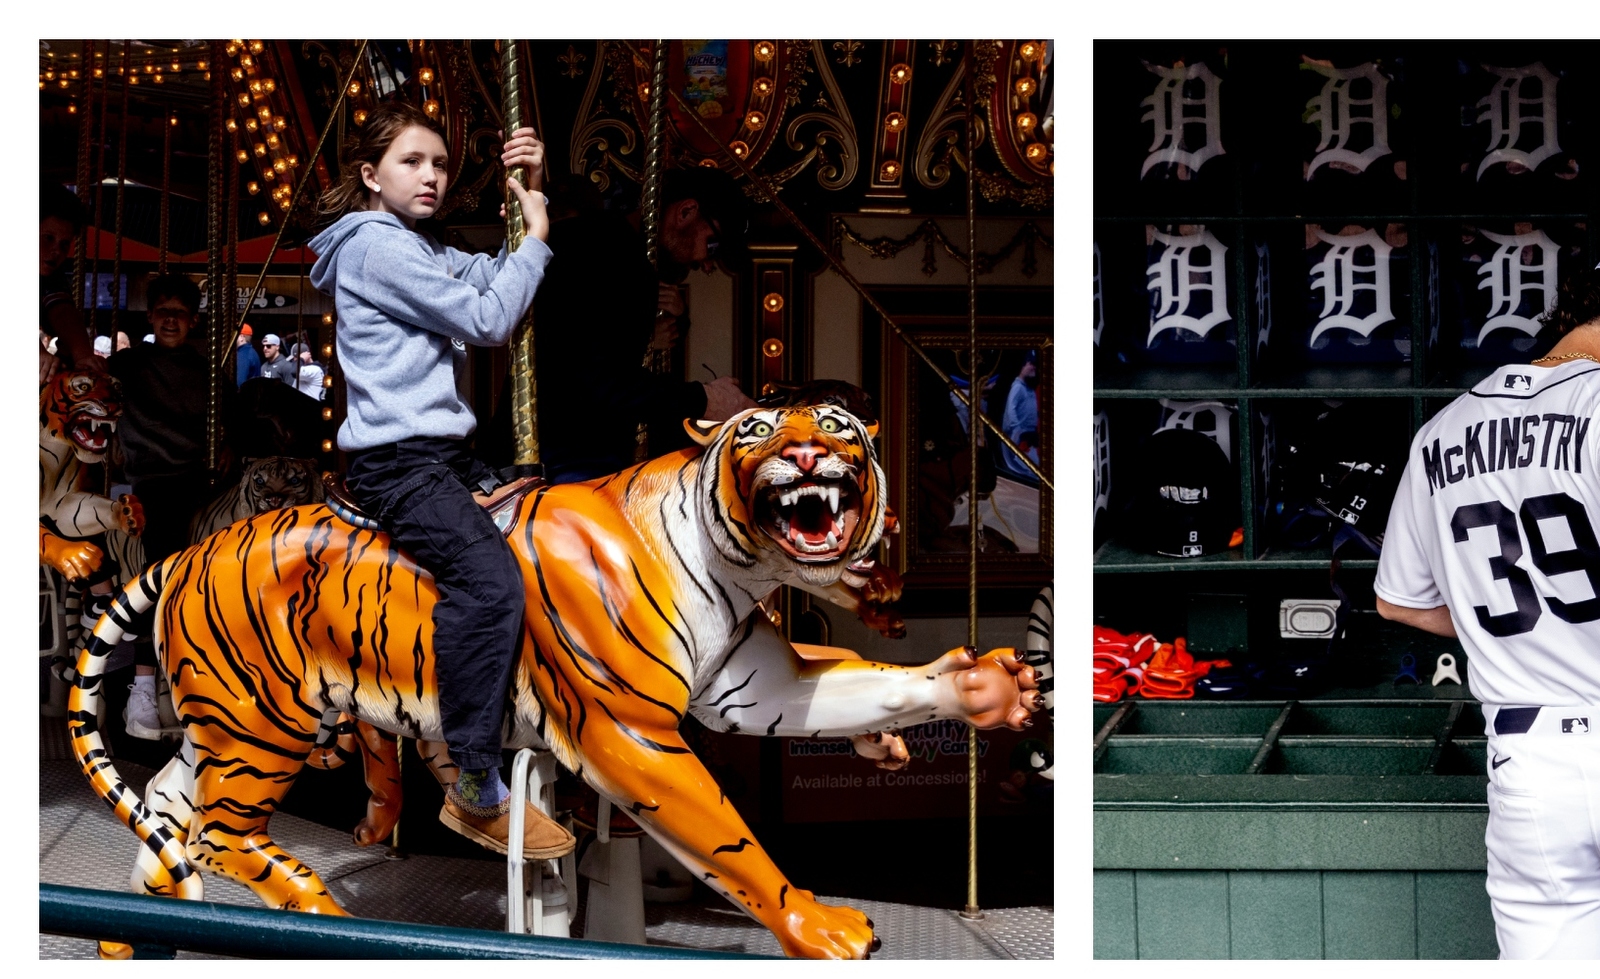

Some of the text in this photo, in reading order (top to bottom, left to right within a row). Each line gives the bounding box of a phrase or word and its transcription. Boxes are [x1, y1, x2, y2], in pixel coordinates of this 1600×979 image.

[1421, 412, 1591, 497] McKINSTRY
[1349, 495, 1367, 510] 13
[1189, 531, 1198, 542] 8
[792, 775, 863, 790] Available
[866, 773, 881, 787] at
